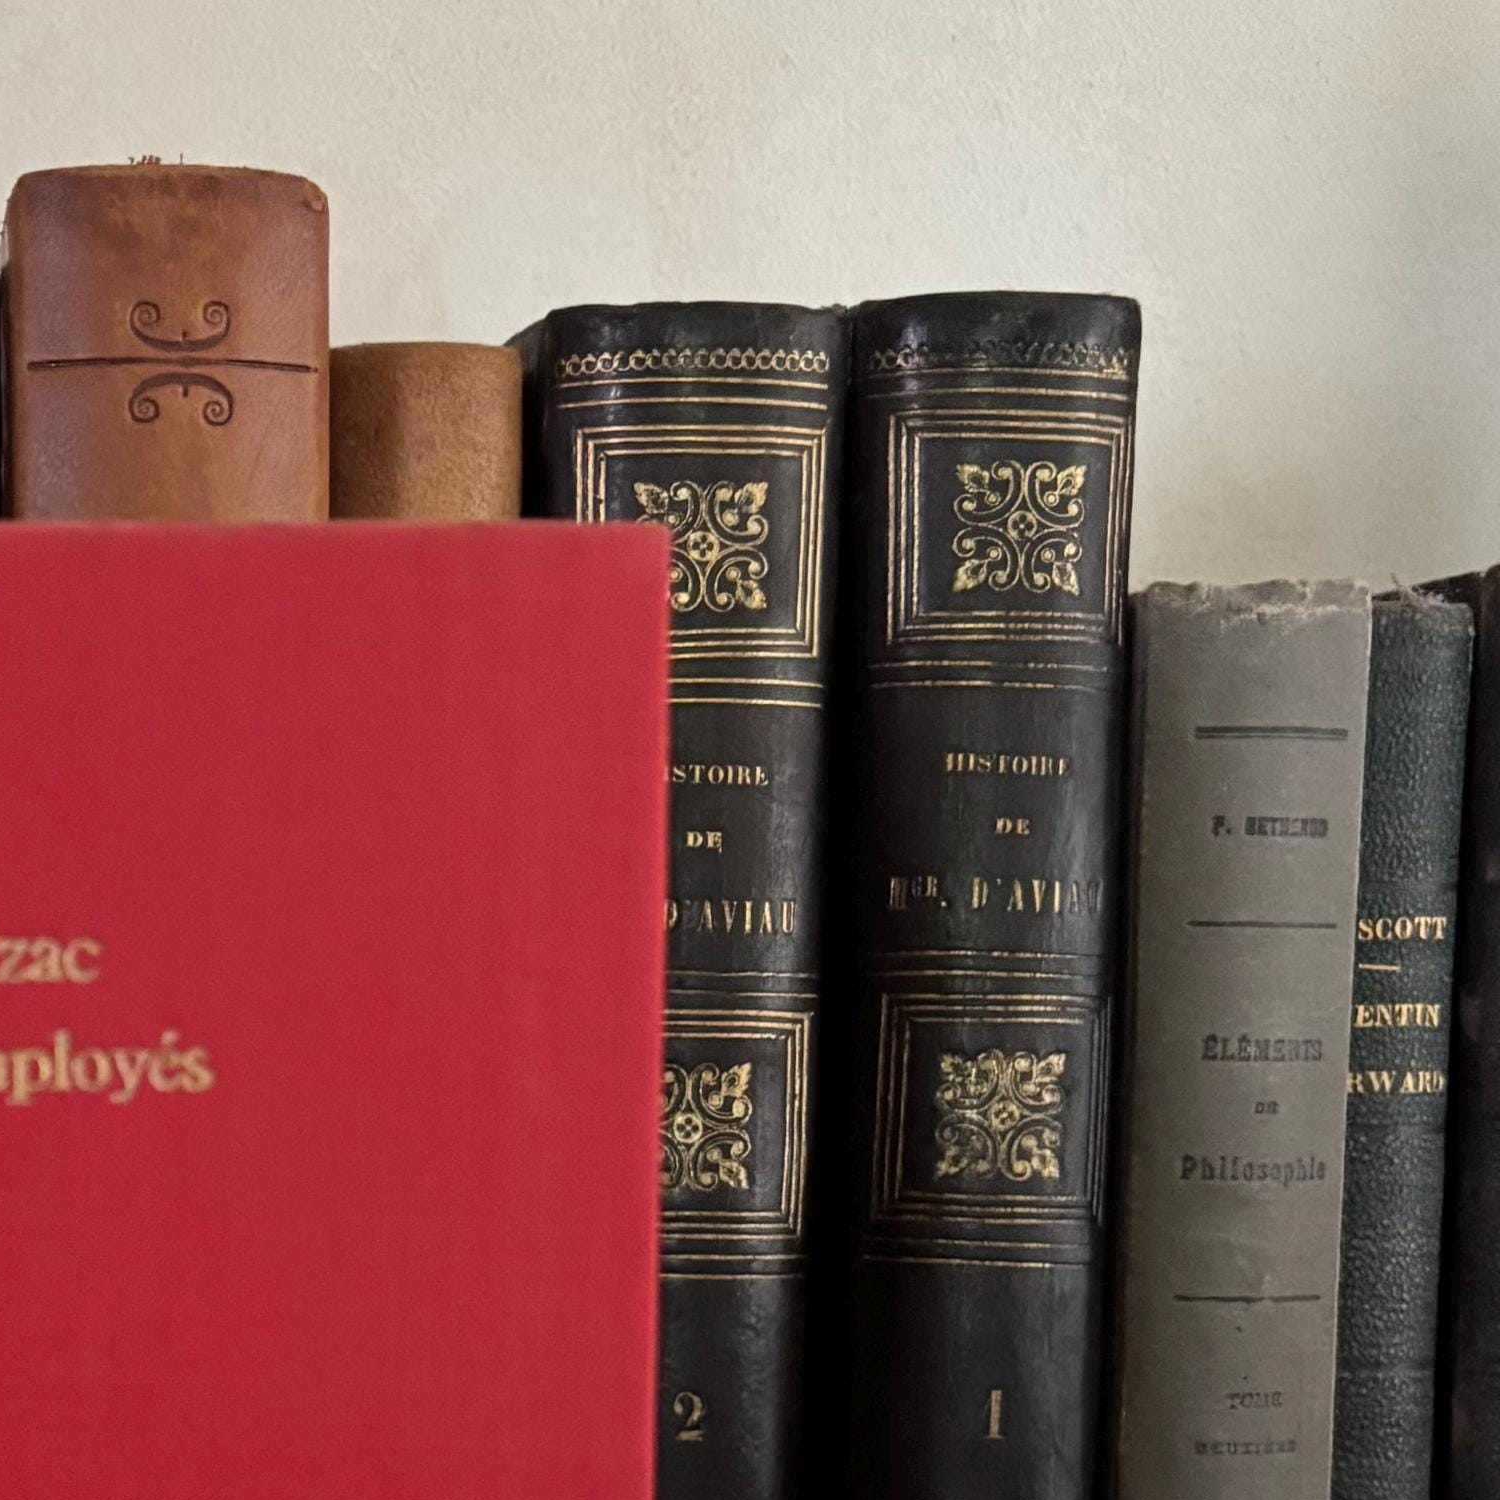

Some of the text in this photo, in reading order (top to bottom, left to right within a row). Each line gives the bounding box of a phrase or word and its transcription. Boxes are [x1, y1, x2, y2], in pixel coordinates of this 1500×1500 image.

[995, 817, 1031, 836] DE
[684, 830, 723, 852] DE
[1358, 916, 1447, 941] SCOTT
[672, 1391, 706, 1441] 2
